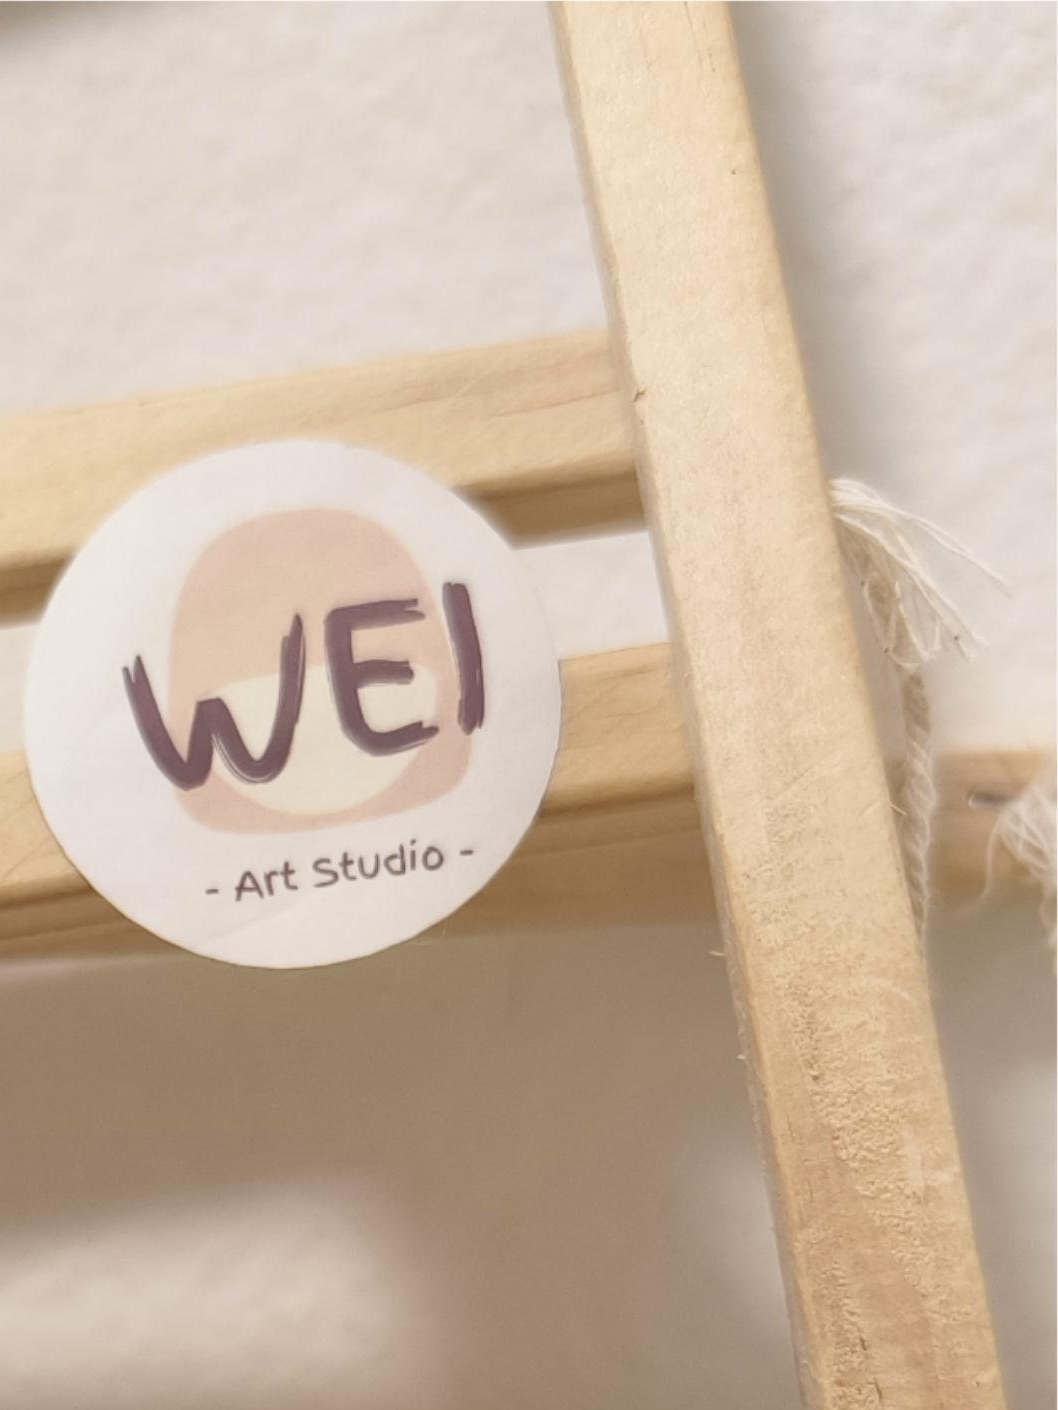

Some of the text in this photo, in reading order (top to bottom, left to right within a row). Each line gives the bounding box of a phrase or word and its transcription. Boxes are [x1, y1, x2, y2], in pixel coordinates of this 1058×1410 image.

[122, 581, 486, 792] WEI
[235, 862, 299, 901] Art
[312, 838, 445, 888] Studio
